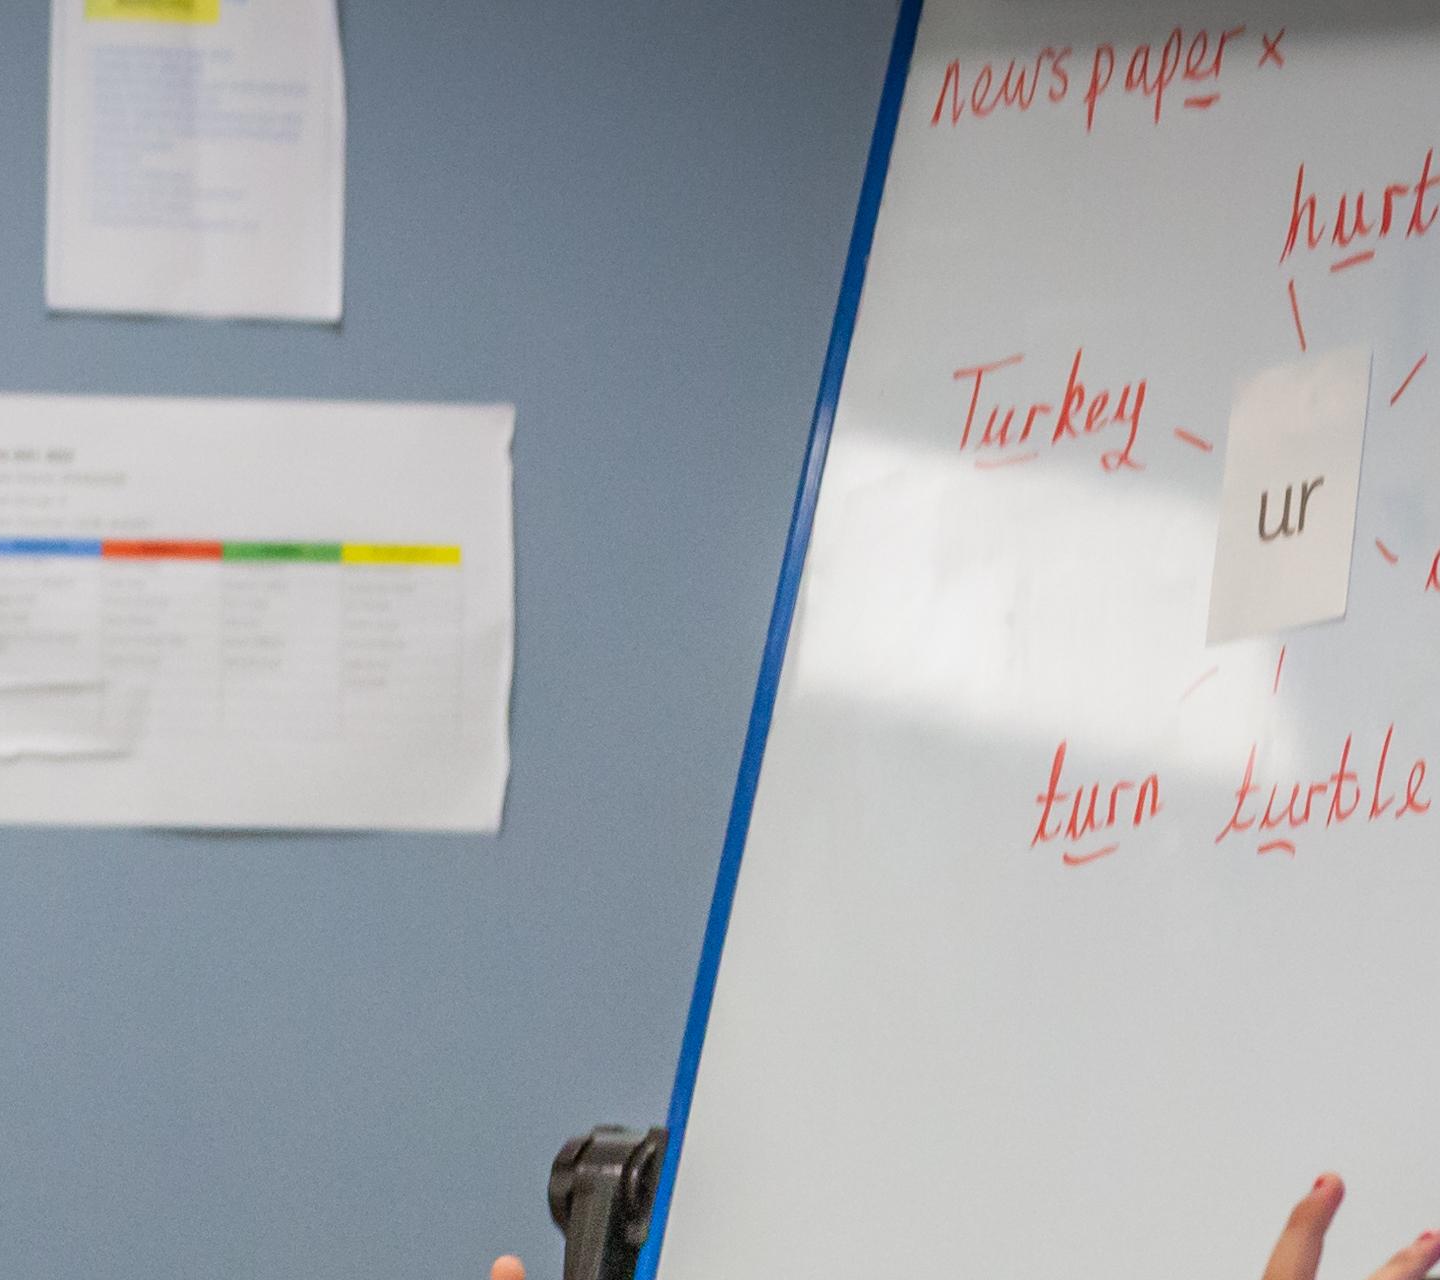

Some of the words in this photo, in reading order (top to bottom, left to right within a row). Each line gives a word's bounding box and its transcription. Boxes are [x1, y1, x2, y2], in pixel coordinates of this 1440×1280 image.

[929, 24, 1247, 134] newspaper
[952, 347, 1149, 472] Turkey
[1256, 475, 1326, 542] ur
[1029, 737, 1165, 849] turn
[1213, 721, 1432, 845] turtle
